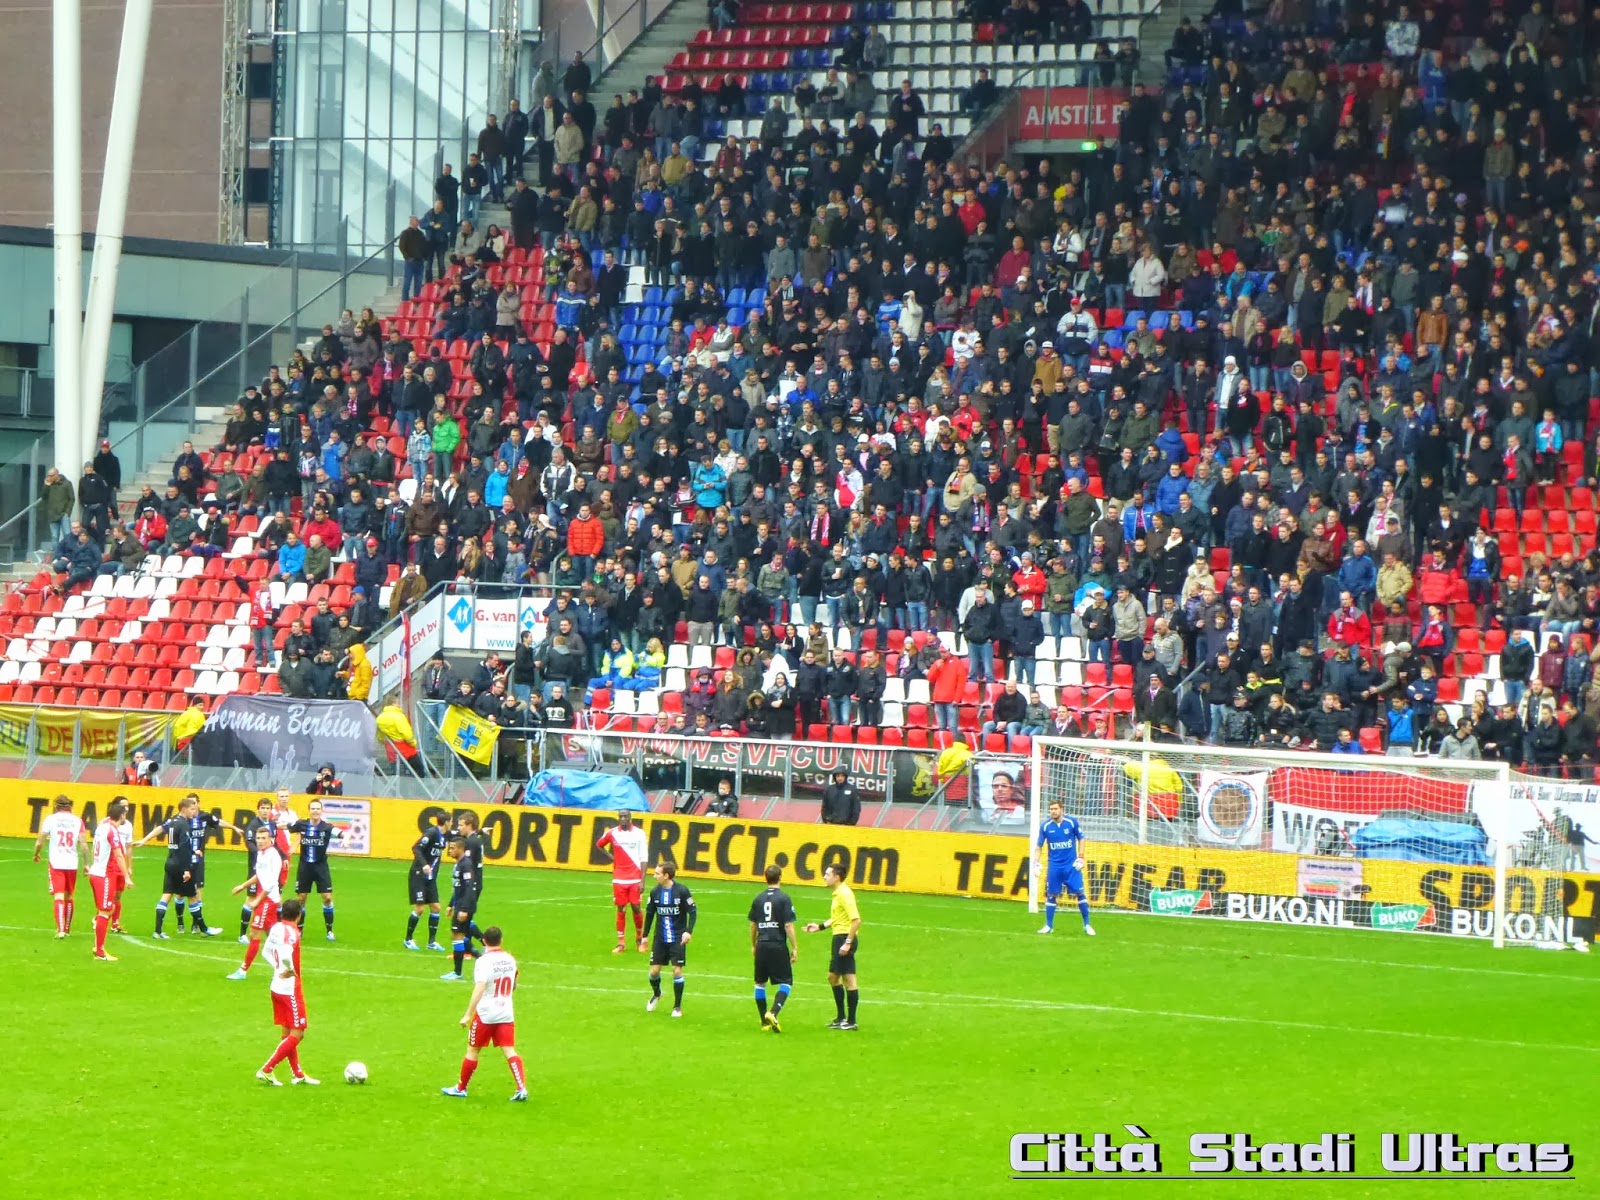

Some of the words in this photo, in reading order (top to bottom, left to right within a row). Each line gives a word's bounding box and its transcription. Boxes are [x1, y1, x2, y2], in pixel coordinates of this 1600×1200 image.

[1025, 104, 1105, 126] AMSTEL
[494, 611, 516, 622] van
[382, 653, 398, 669] van
[57, 831, 74, 848] 28
[954, 852, 1228, 911] TEAWEAR
[763, 901, 772, 922] 9
[1156, 893, 1195, 910] BUKO
[1227, 893, 1354, 927] BUKO.NL
[1378, 907, 1419, 926] BUKO
[1451, 908, 1584, 944] BUKO.NL
[493, 976, 512, 998] 10
